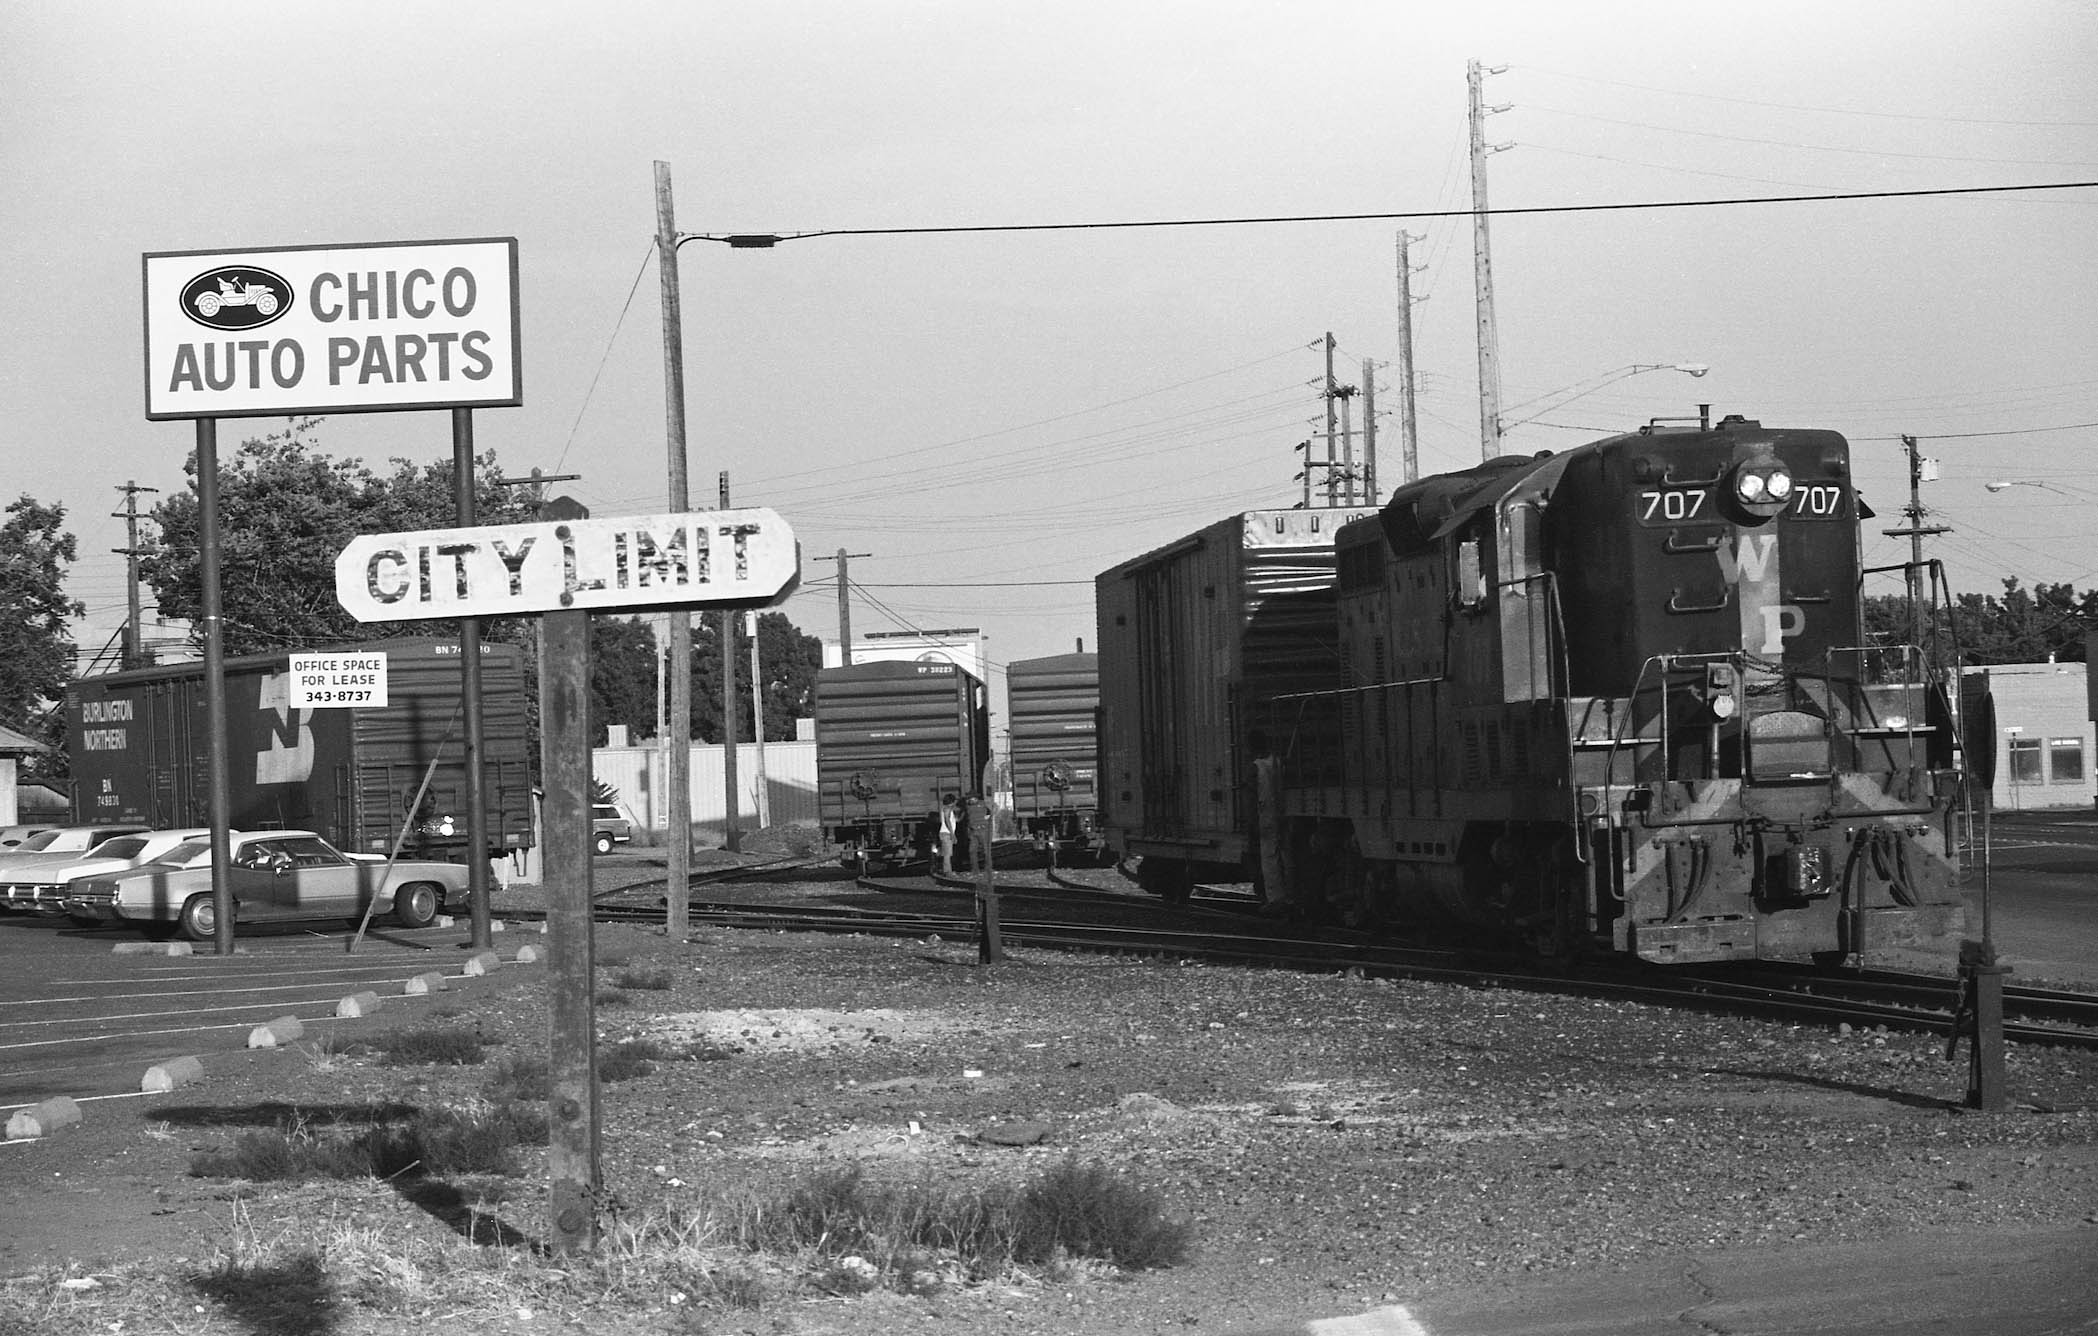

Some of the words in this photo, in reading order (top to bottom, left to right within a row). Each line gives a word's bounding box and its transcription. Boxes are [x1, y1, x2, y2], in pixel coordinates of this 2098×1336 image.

[309, 266, 477, 323] CHICO
[168, 337, 305, 393] AUTO
[328, 330, 494, 386] PARTS
[1641, 489, 1706, 520] 707
[1794, 486, 1841, 515] 707
[366, 536, 538, 604] CITY
[562, 522, 761, 593] LIMIT
[435, 645, 449, 655] BN
[294, 660, 338, 672] OFFICE
[342, 659, 381, 671] SPACE
[301, 675, 325, 686] FOR
[332, 674, 376, 685] LEASE
[82, 699, 133, 723] BURLINGTON
[83, 728, 127, 751] NORTHERN
